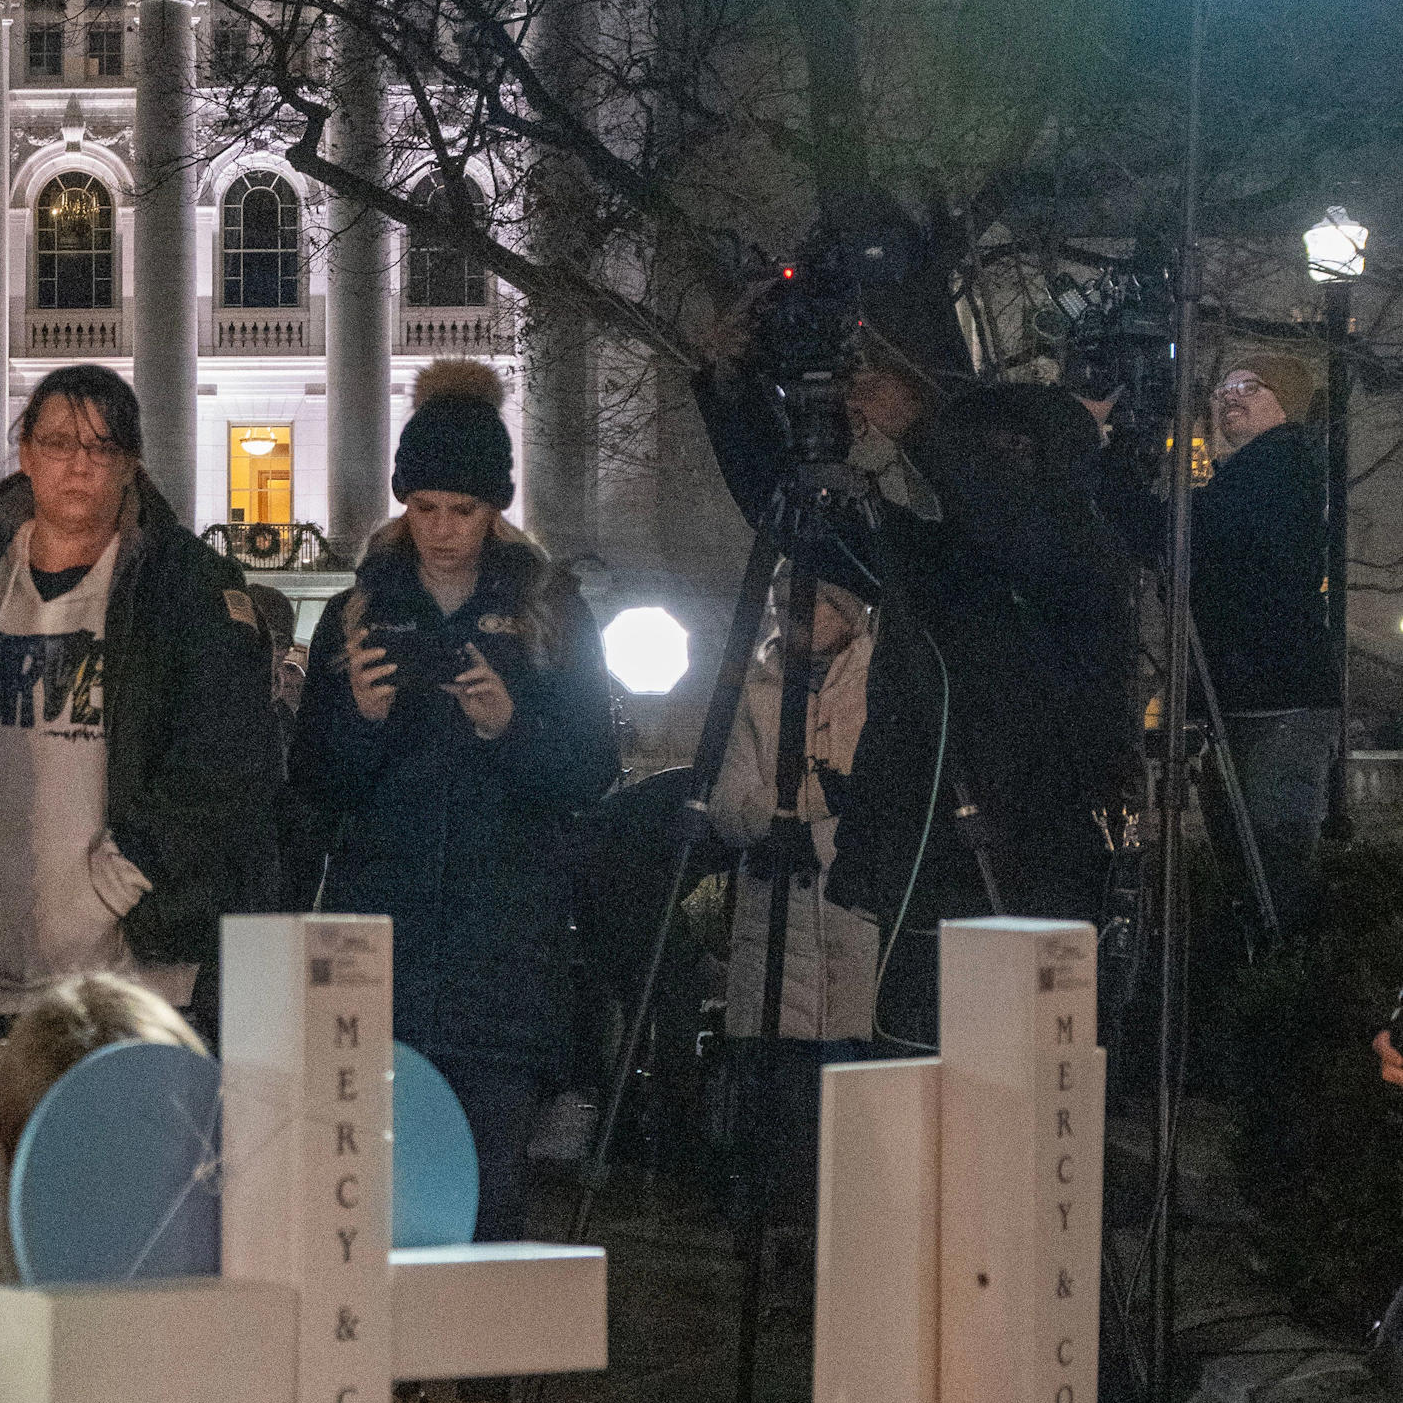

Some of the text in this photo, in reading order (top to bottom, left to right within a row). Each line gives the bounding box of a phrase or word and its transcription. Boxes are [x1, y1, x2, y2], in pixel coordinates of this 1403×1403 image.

[334, 1015, 360, 1264] MERCY
[1055, 1015, 1074, 1232] MERCY
[335, 1305, 360, 1343] &
[1055, 1267, 1073, 1300] &
